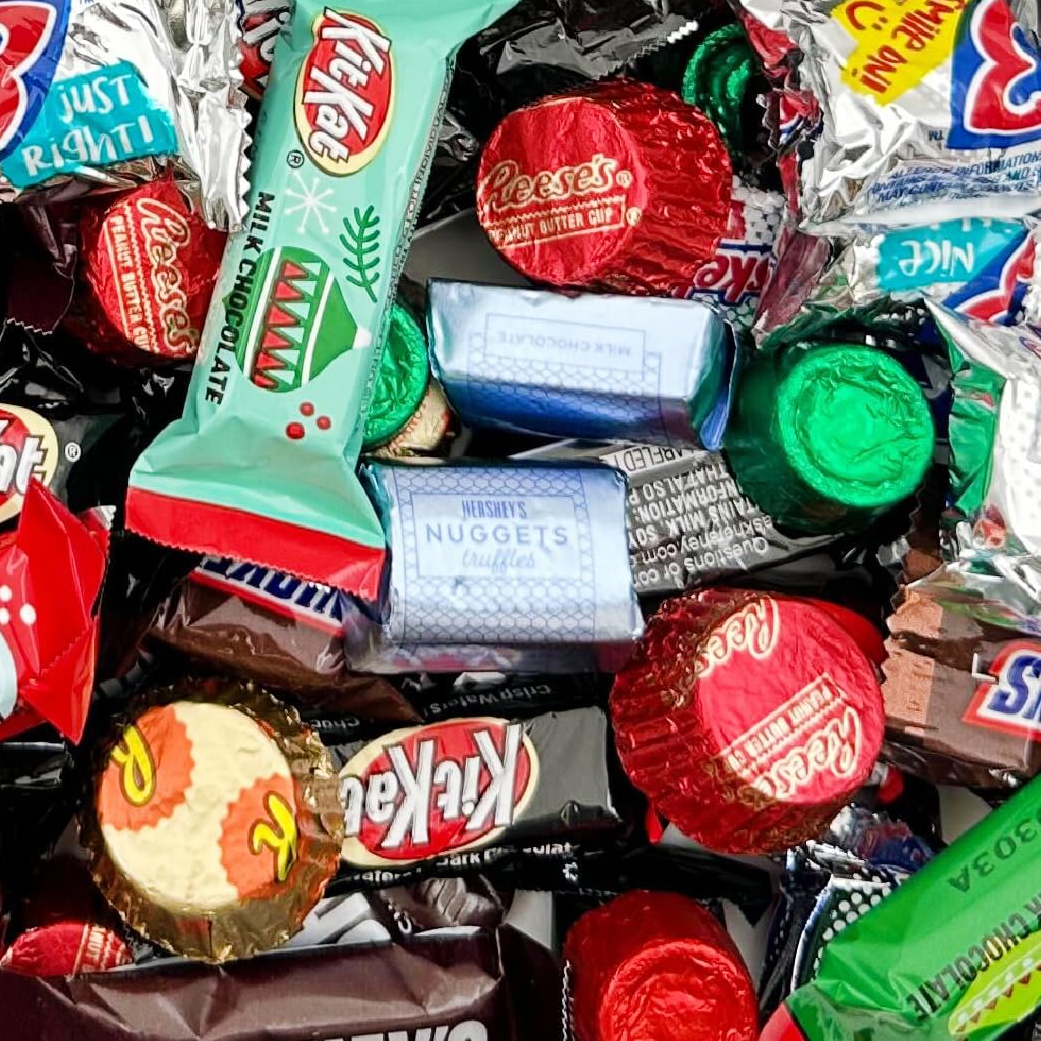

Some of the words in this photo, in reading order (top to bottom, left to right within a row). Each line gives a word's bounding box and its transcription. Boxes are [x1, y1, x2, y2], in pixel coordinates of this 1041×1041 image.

[300, 7, 392, 165] KitKat
[483, 154, 618, 210] Reese's
[109, 218, 133, 268] PEANUT
[241, 190, 277, 255] MILK
[540, 211, 585, 237] BUTTER
[588, 206, 613, 230] CUP
[119, 268, 144, 323] BUTTER
[199, 257, 262, 407] CHOCOLATE
[426, 522, 570, 547] NUGGETS
[462, 499, 527, 520] HERSHEY'S
[462, 550, 535, 573] truffles
[682, 534, 769, 575] Questions
[340, 723, 524, 849] KitKat
